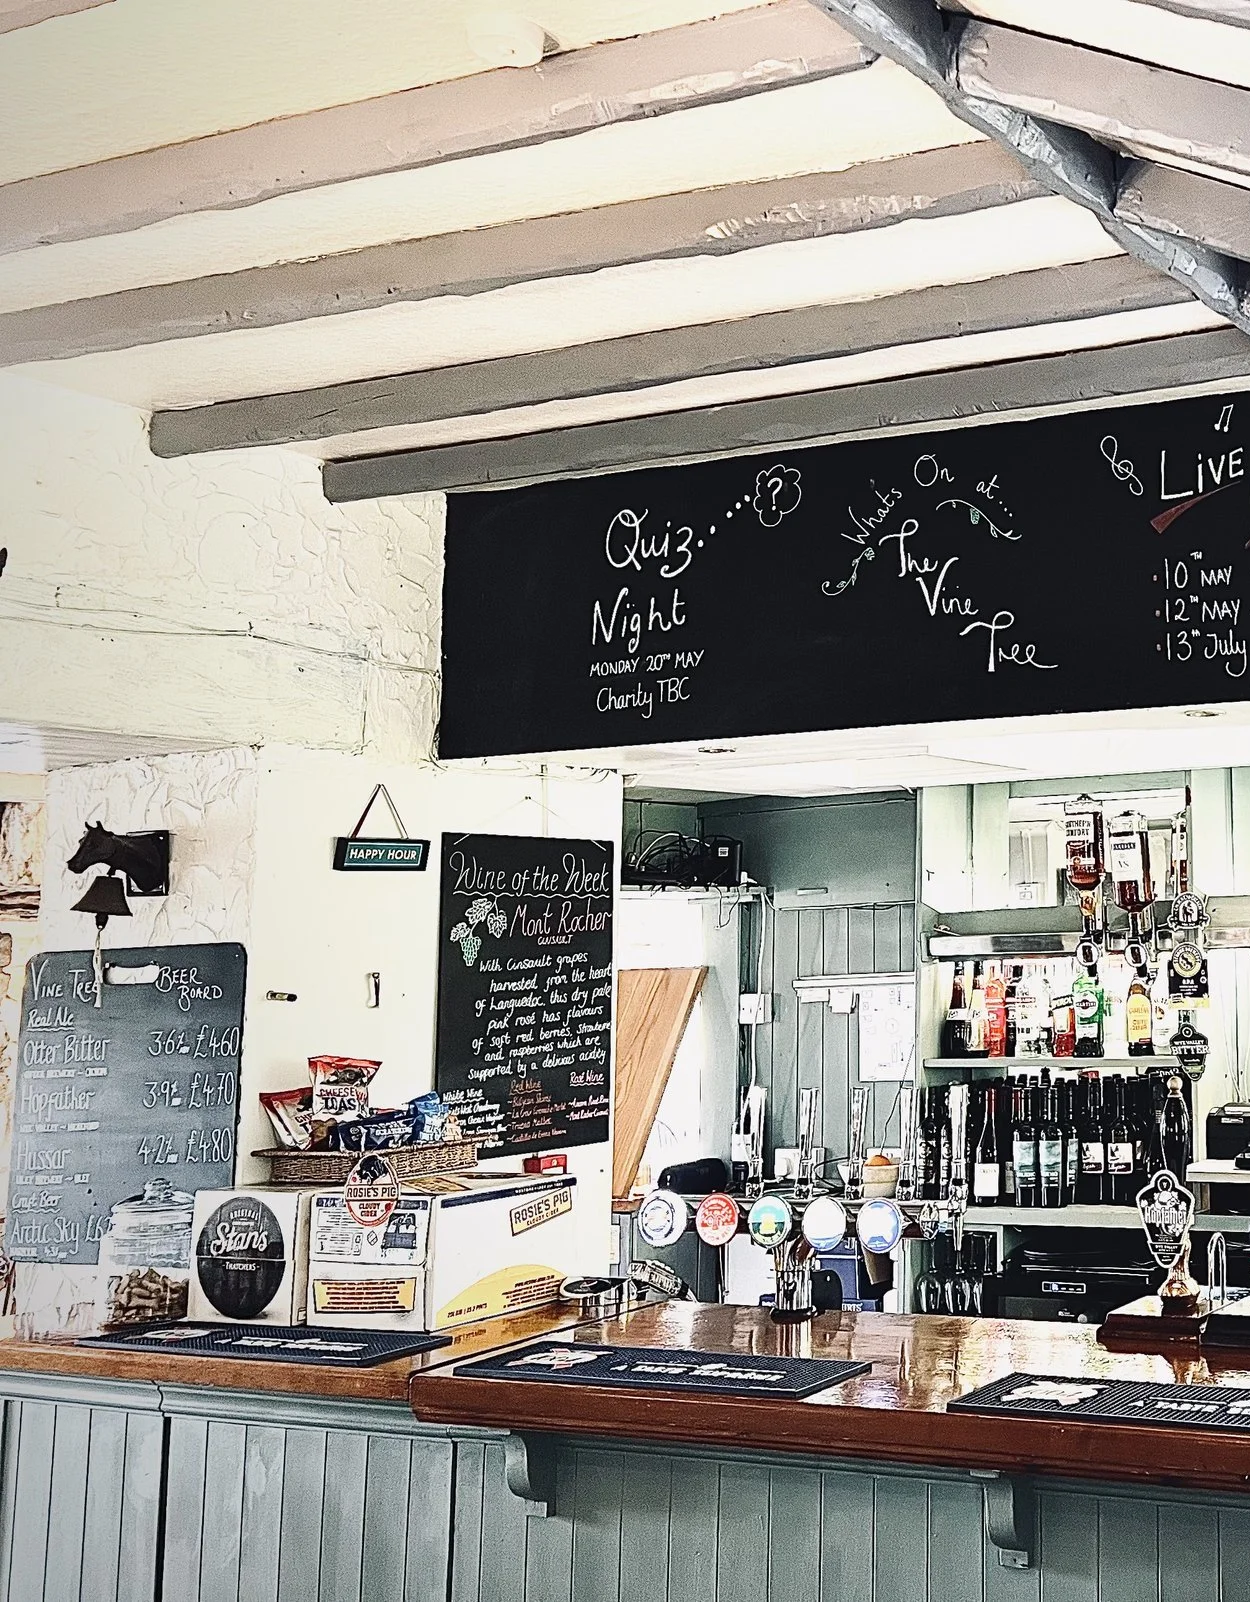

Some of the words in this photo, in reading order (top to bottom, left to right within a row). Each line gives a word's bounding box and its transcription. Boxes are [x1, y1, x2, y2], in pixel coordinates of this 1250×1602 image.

[913, 454, 954, 486] On
[606, 509, 693, 577] Quiz
[879, 519, 938, 577] The
[916, 557, 978, 616] Vine
[1201, 566, 1232, 587] MAY
[592, 588, 686, 652] Night
[1202, 599, 1240, 625] MAY
[960, 612, 1058, 672] Tree
[1204, 629, 1247, 676] July
[590, 658, 640, 677] MONDAY
[674, 650, 705, 669] MAY
[597, 685, 653, 718] Charity
[657, 677, 690, 703] TBC
[350, 849, 385, 859] HAPPY
[387, 850, 417, 859] HOUR
[450, 852, 506, 889] Wine
[512, 870, 529, 896] of
[533, 866, 559, 891] the
[563, 853, 609, 892] Week
[510, 903, 552, 937] Mont
[558, 898, 612, 933] Rocher
[480, 958, 502, 972] With
[507, 954, 552, 970] Cinsault
[557, 953, 588, 973] grapes
[490, 973, 538, 993] harvested
[544, 973, 568, 992] from
[572, 968, 586, 982] the
[589, 962, 612, 980] heart
[155, 967, 202, 993] BEER
[177, 985, 223, 1011] BOARD
[475, 999, 486, 1017] of
[550, 990, 568, 1004] this
[572, 987, 588, 1008] dry
[592, 983, 612, 1004] pale
[27, 1009, 52, 1028] Real
[54, 1007, 74, 1026] Ale
[487, 1015, 508, 1035] pink
[542, 1010, 560, 1023] has
[563, 1005, 604, 1026] flavours
[24, 1039, 61, 1066] Otter
[65, 1034, 110, 1064] Bitter
[193, 1024, 240, 1059] £4.60
[472, 1039, 483, 1055] of
[490, 1032, 510, 1048] soft
[516, 1029, 534, 1042] red
[485, 1050, 504, 1061] and
[510, 1042, 553, 1058] raspberries
[557, 1037, 582, 1052] which
[585, 1036, 601, 1046] are
[1171, 1045, 1210, 1055] BITTER
[517, 1060, 527, 1078] by
[531, 1062, 538, 1070] a
[542, 1052, 575, 1068] delicious
[580, 1050, 606, 1065] acidity
[586, 1071, 604, 1082] Wine
[21, 1085, 95, 1122] Hopfather
[189, 1072, 235, 1109] £4.70
[319, 1087, 355, 1097] CHEESE
[442, 1089, 465, 1101] White
[466, 1088, 483, 1097] Wine
[510, 1079, 524, 1091] Red
[16, 1140, 72, 1171] Hussar
[186, 1128, 232, 1163] £4.80
[347, 1187, 378, 1198] ROSIE'S
[381, 1187, 396, 1197] PIG
[514, 1199, 550, 1224] ROSIE'S
[553, 1191, 568, 1207] PIG
[527, 1214, 544, 1226] CLOUDY
[546, 1208, 559, 1217] CIDER
[11, 1219, 52, 1244] Arctic
[54, 1217, 80, 1255] Sky
[210, 1222, 268, 1256] Stan's
